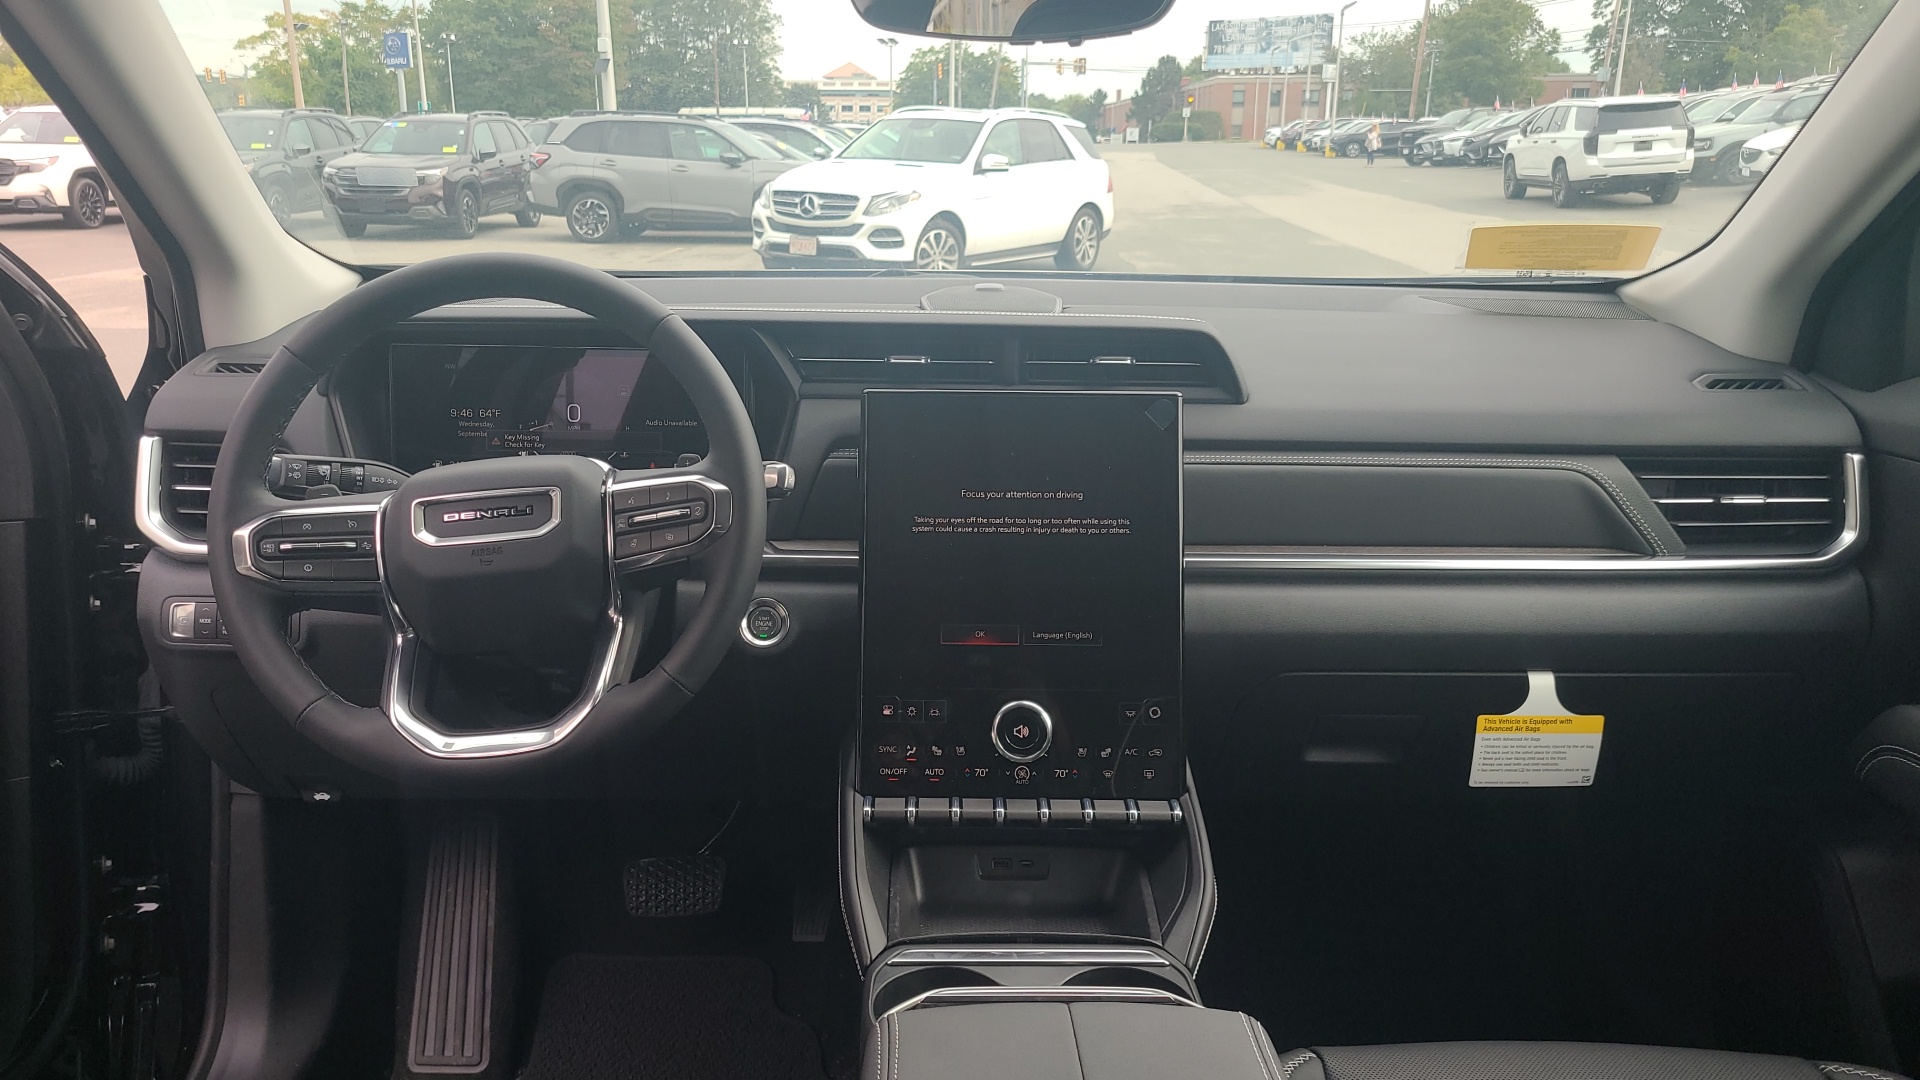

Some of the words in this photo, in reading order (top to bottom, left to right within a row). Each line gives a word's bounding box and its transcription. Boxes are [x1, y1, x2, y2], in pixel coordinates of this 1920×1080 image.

[1212, 21, 1244, 32] LAKESIDE
[1222, 34, 1252, 42] LEASING
[1214, 44, 1226, 54] 781
[450, 408, 473, 418] 9:46
[479, 408, 501, 418] 64°F
[567, 404, 580, 422] 0
[961, 490, 985, 498] Focus
[986, 492, 1004, 500] your
[1006, 490, 1042, 499] attention
[1056, 490, 1083, 501] driving
[443, 504, 534, 522] DENALI
[914, 516, 934, 524] Taking
[1028, 517, 1042, 526] long
[998, 526, 1025, 534] resulting
[1033, 526, 1051, 534] injury
[471, 547, 503, 557] AIRBAG
[1033, 631, 1064, 640] Language
[1065, 631, 1093, 640] (English)
[974, 768, 989, 777] 70°
[1054, 770, 1069, 778] 70°
